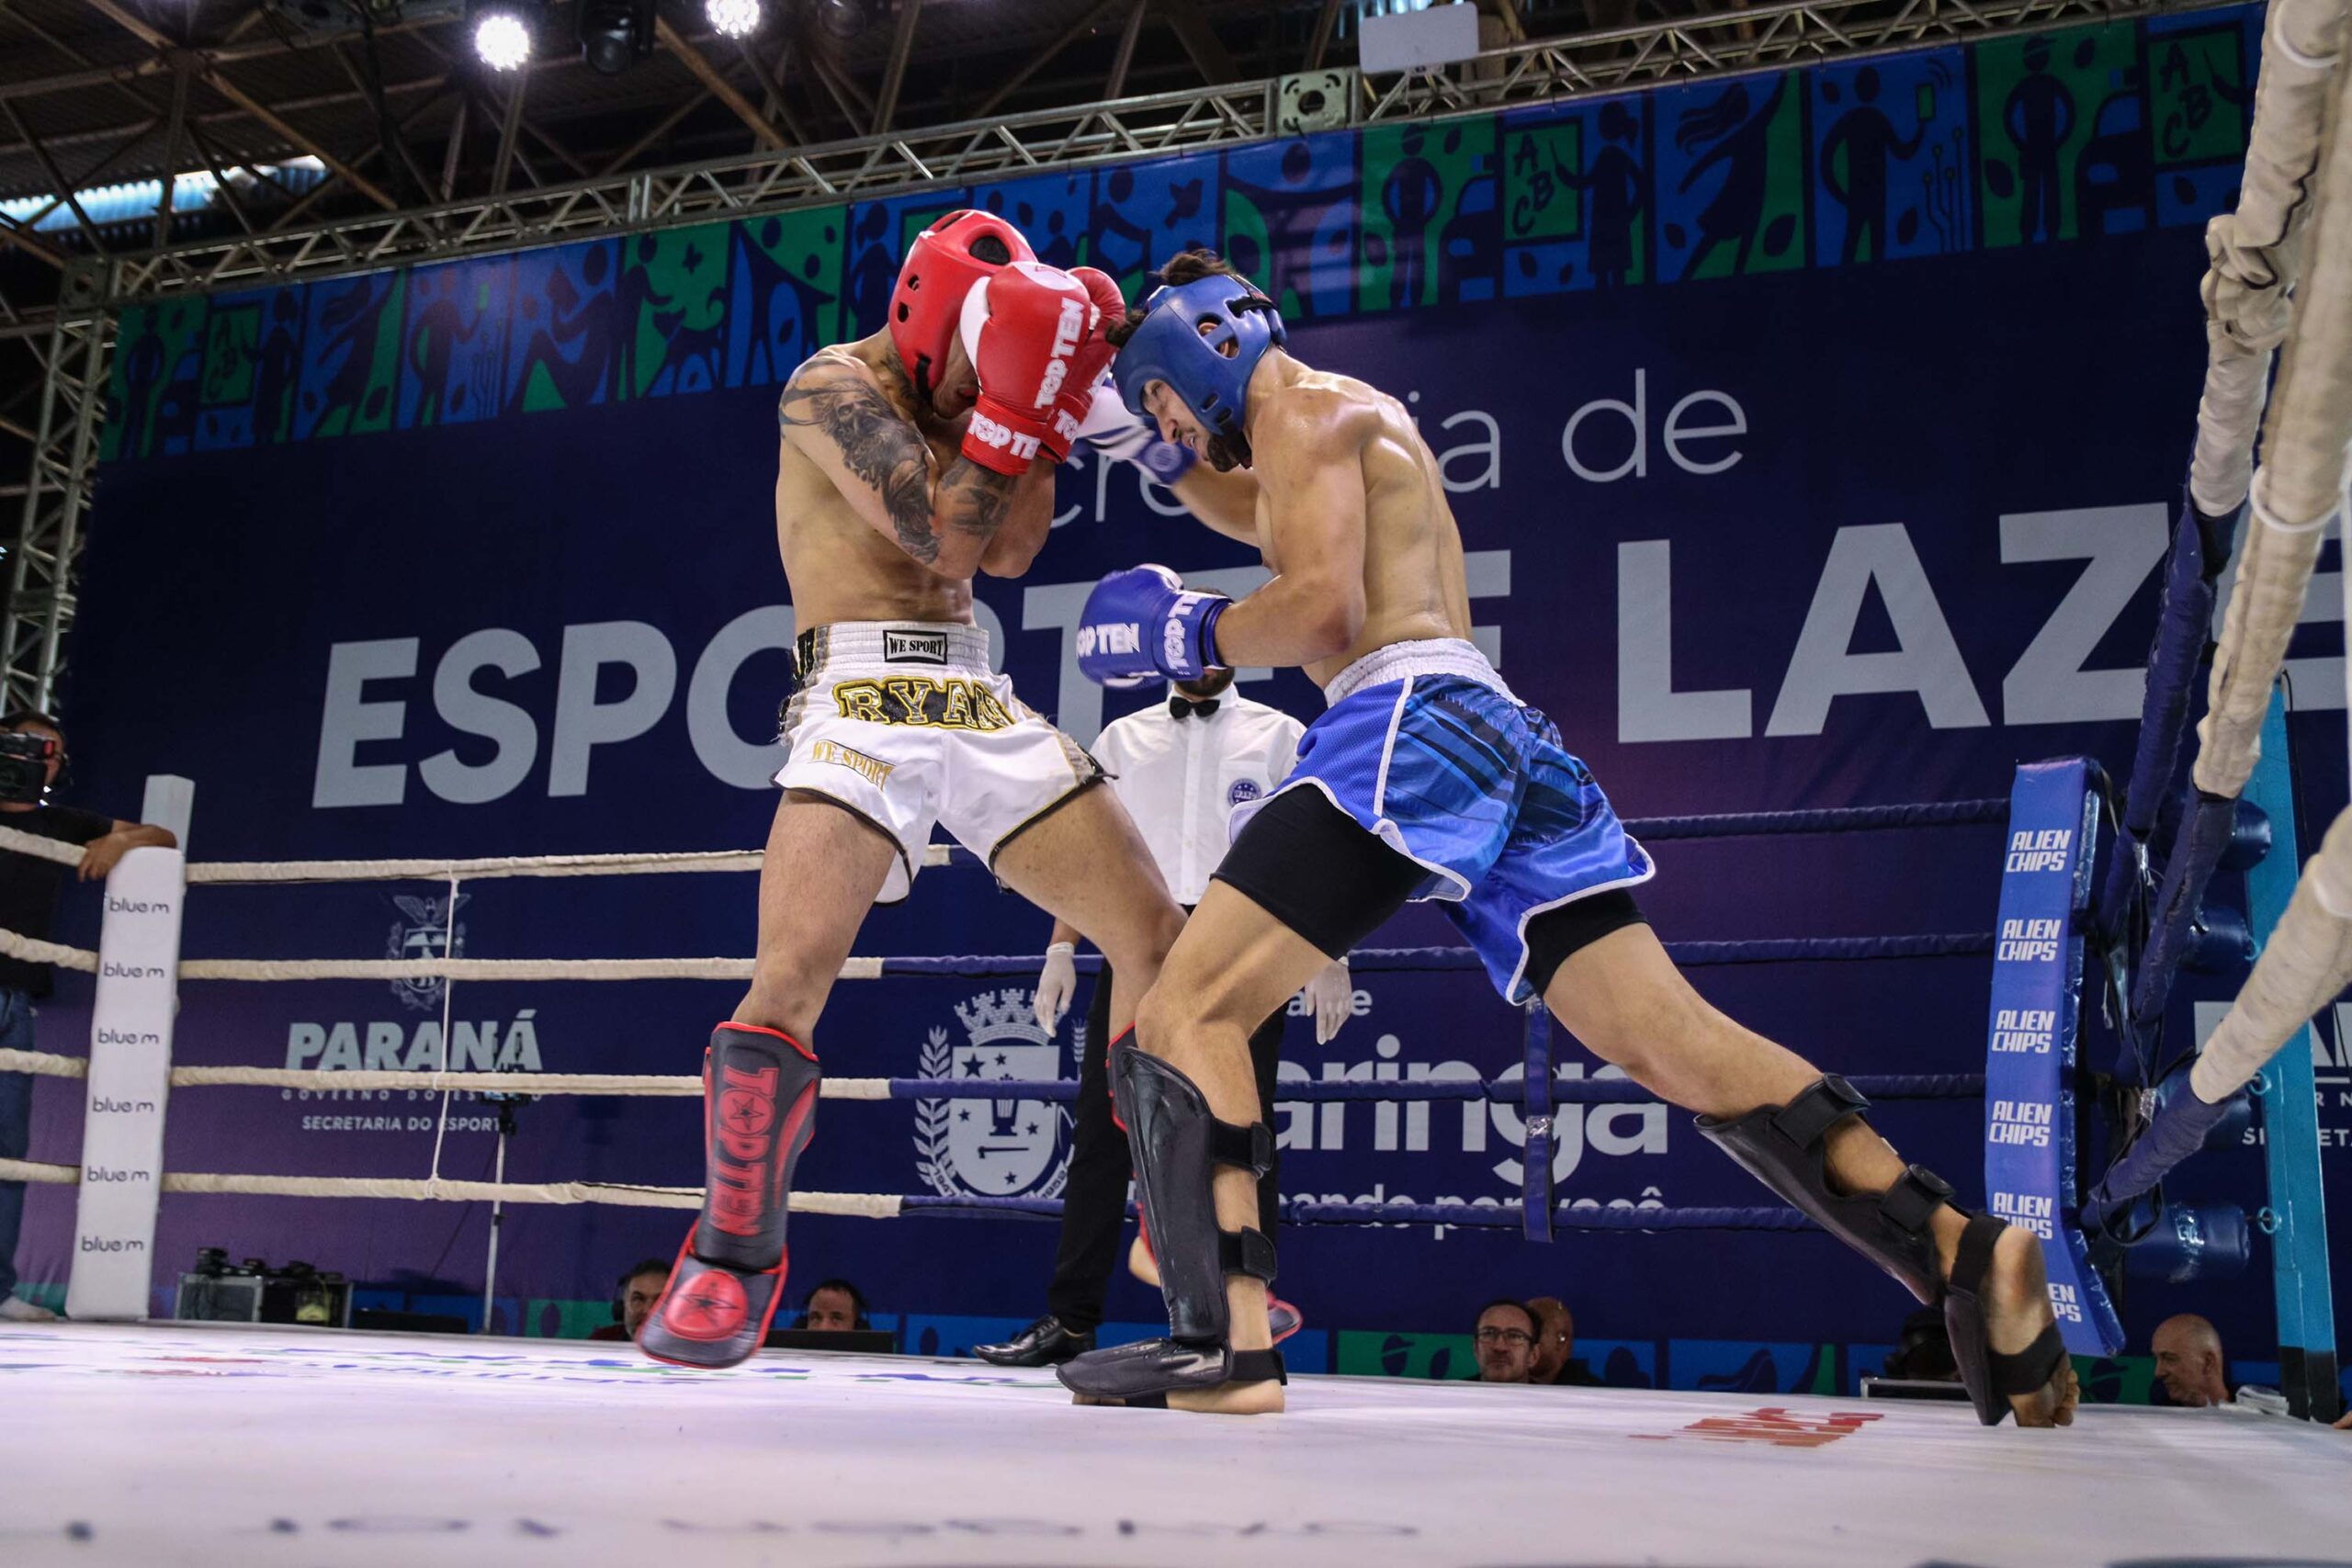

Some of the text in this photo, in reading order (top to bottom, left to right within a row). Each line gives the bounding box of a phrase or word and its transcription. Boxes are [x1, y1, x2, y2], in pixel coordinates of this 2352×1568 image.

[967, 411, 1041, 459] TOP TE
[1054, 408, 1080, 445] TO
[1562, 367, 1747, 483] de
[888, 637, 944, 658] WE SPORT
[1096, 622, 1140, 655] TEN
[1164, 617, 1191, 671] TOP
[840, 680, 1014, 730] RYAN
[840, 749, 898, 794] SPORT
[2010, 829, 2072, 852] ALIEN
[2006, 851, 2067, 873] CHIPS
[2002, 919, 2061, 940] ALIEN
[1997, 940, 2058, 962] CHIPS
[1996, 1010, 2055, 1032] ALIEN
[284, 1009, 544, 1071] PARANÁ
[1991, 1031, 2052, 1054] CHIPS
[301, 1115, 401, 1132] SECRETARIA
[407, 1116, 433, 1132] DO
[716, 1066, 780, 1162] TOP
[1992, 1100, 2052, 1125] ALIEN
[1988, 1122, 2051, 1147] CHIPS
[1993, 1191, 2052, 1218] ALIEN
